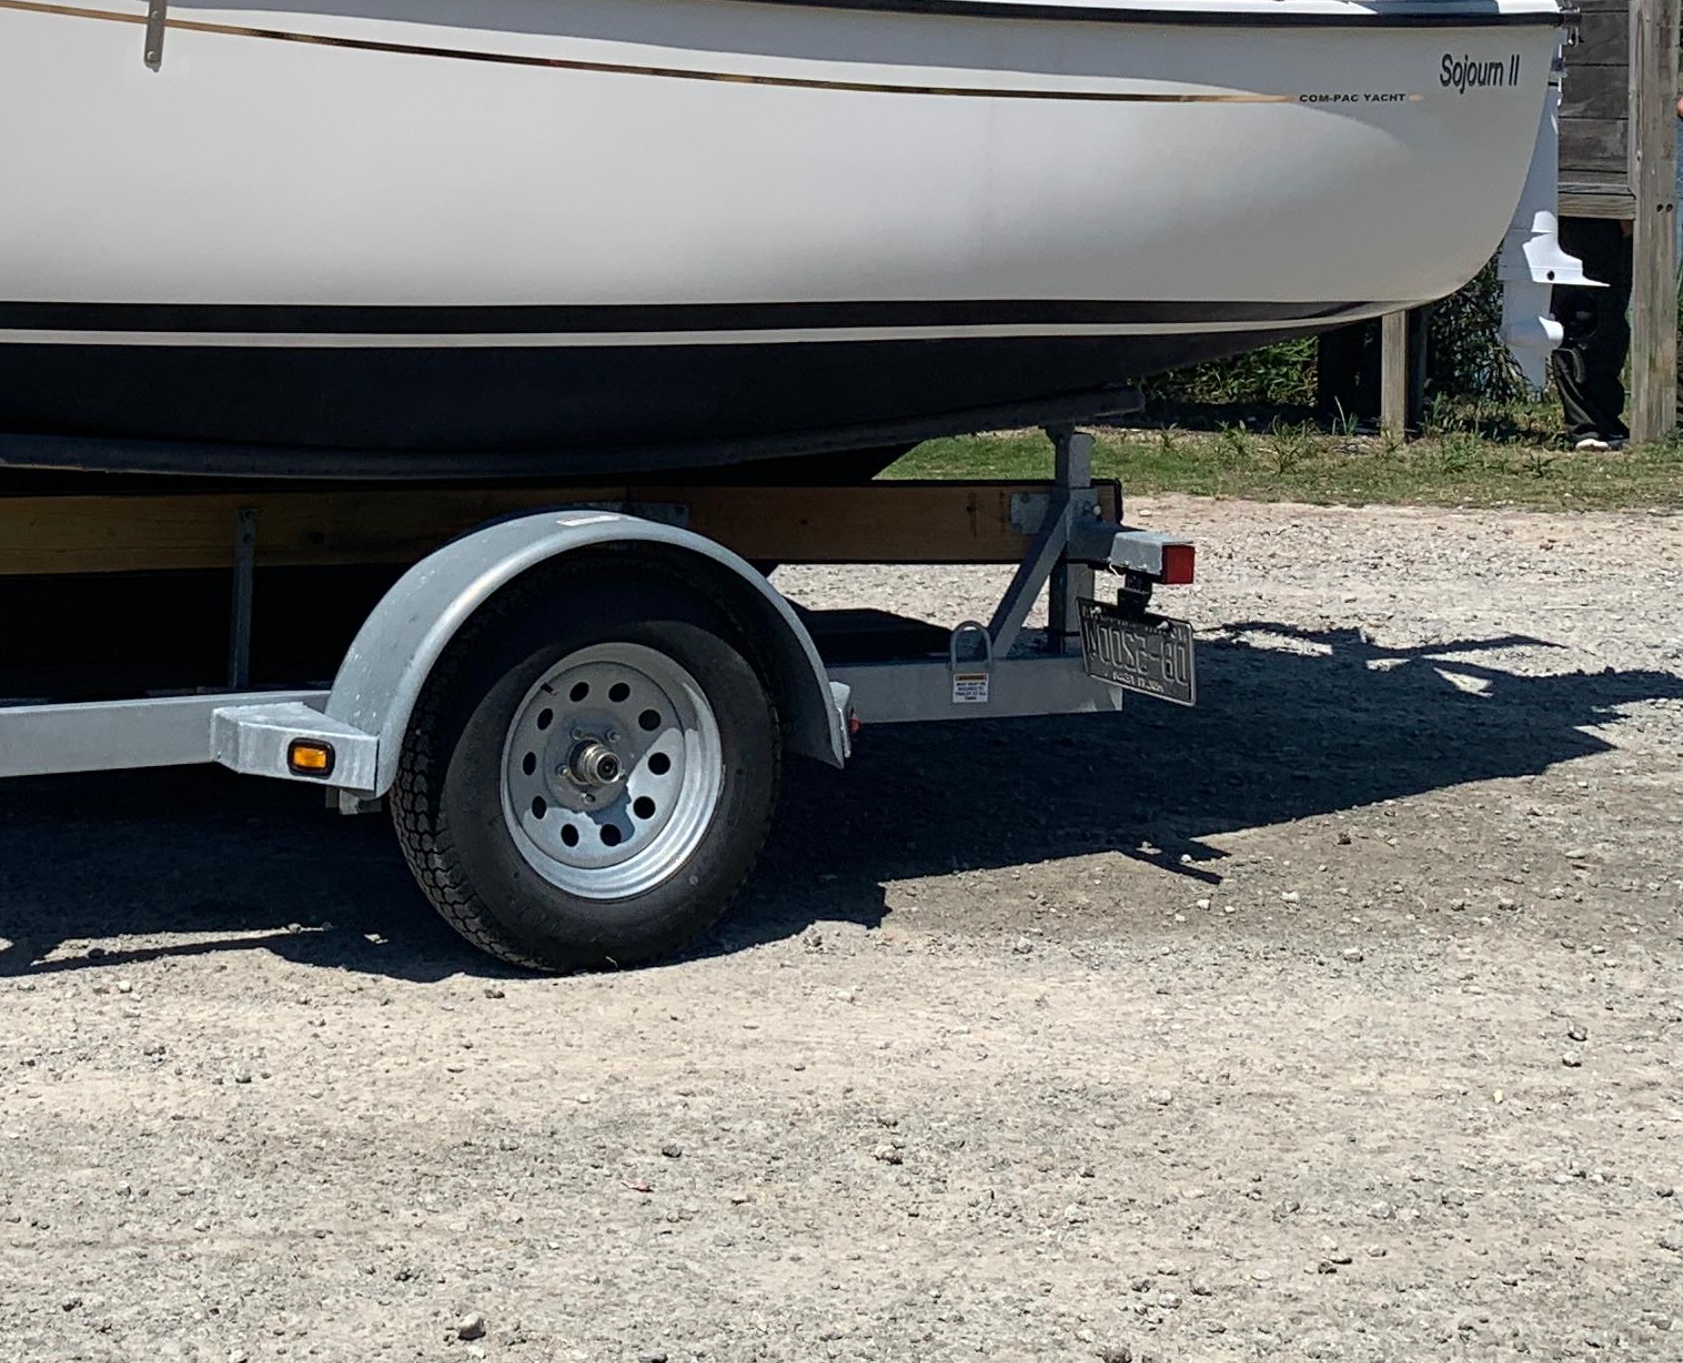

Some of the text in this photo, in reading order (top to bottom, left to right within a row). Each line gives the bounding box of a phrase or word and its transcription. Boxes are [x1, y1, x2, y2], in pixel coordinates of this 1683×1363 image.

[1439, 53, 1520, 95] Sojourn II
[1299, 93, 1406, 103] COM-PAC YACHT
